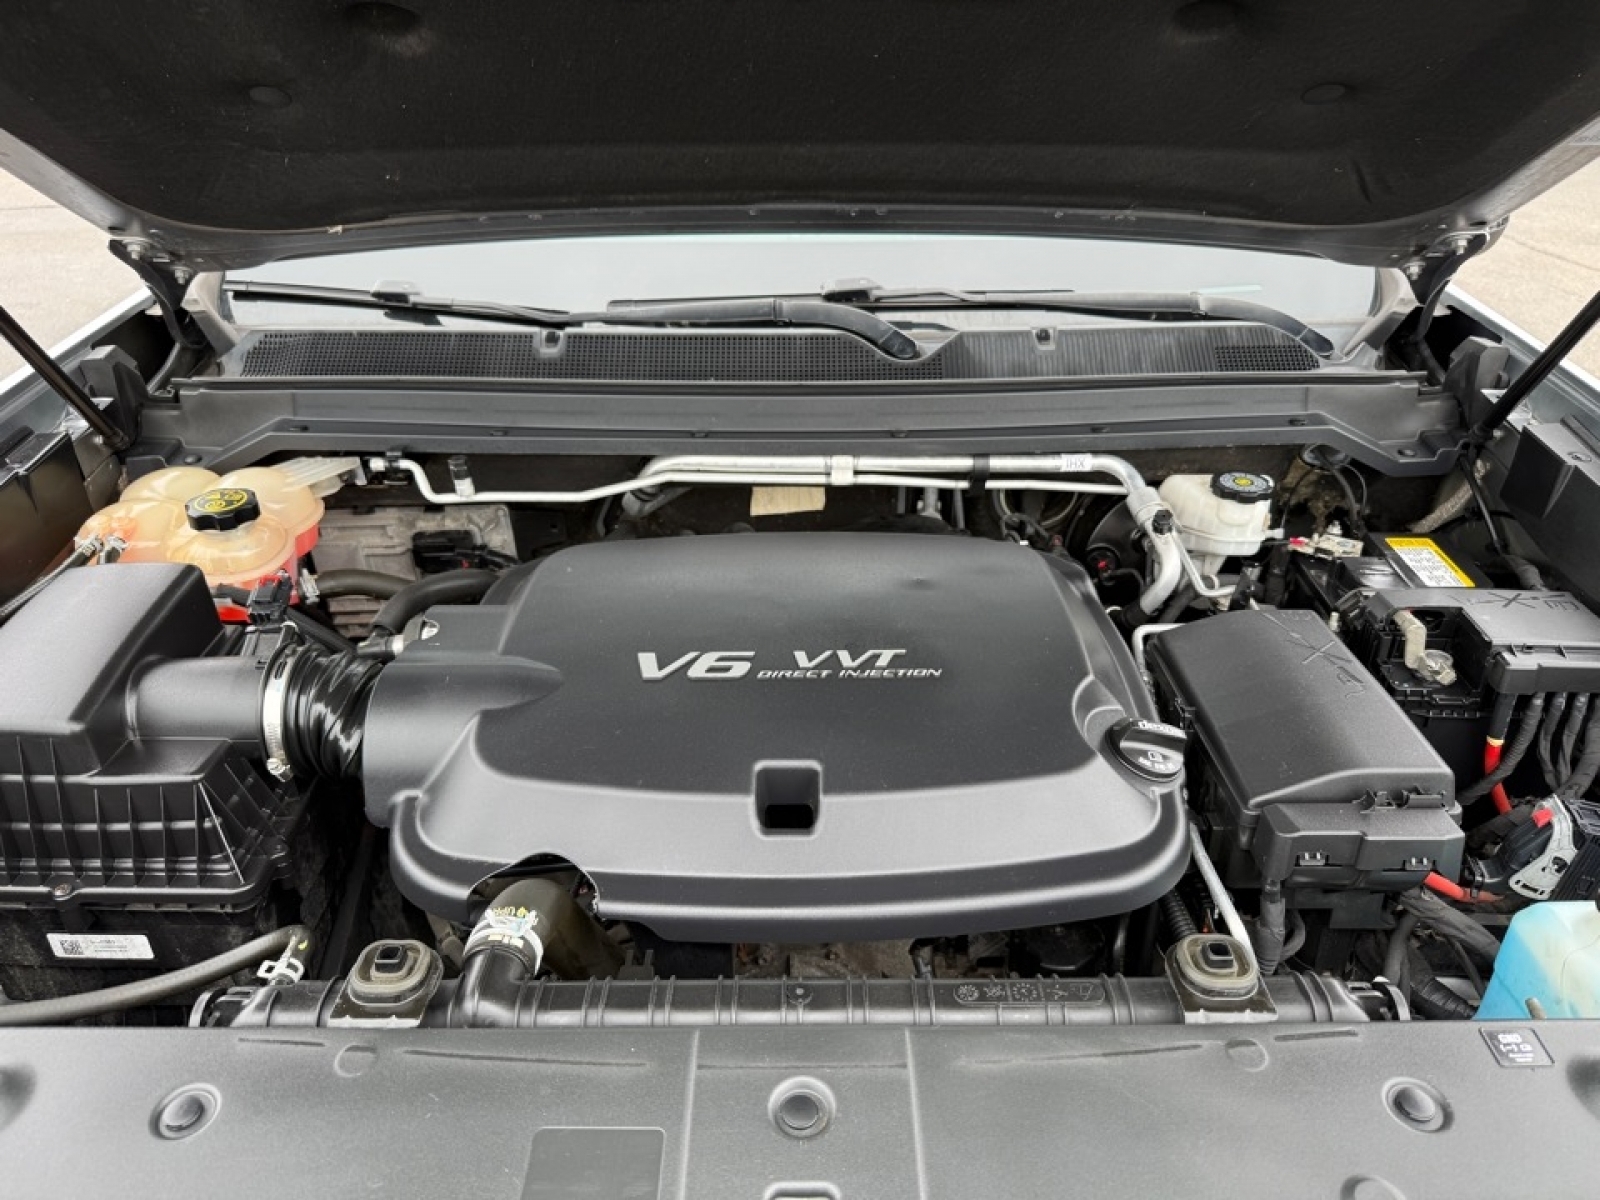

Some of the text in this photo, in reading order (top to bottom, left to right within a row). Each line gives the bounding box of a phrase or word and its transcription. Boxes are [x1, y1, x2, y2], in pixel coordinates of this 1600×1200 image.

[637, 651, 755, 679] V6
[793, 649, 906, 668] VVT
[756, 667, 943, 679] DIRECT INJECTION
